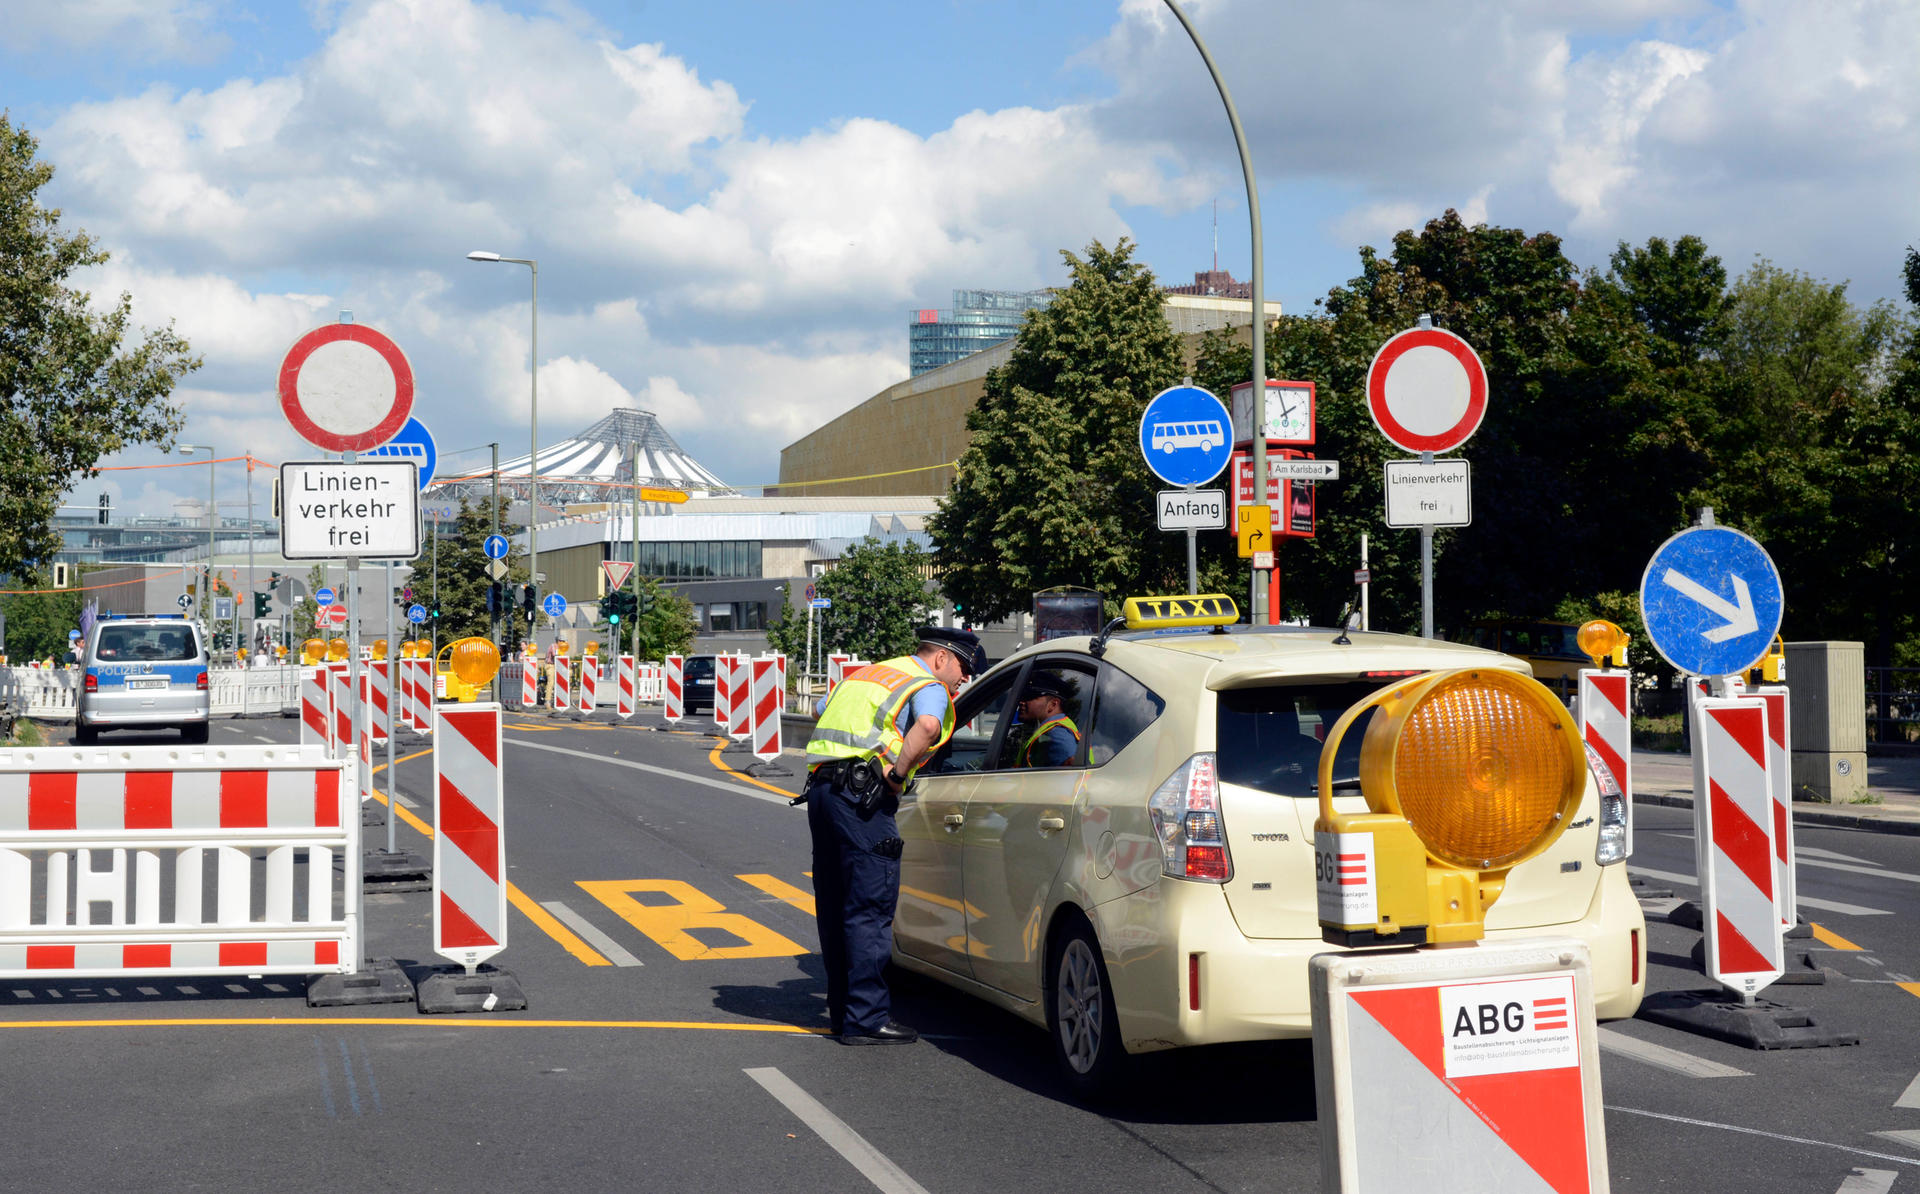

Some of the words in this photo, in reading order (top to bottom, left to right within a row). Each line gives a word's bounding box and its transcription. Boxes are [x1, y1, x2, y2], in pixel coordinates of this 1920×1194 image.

[1275, 464, 1288, 473] Am
[1290, 464, 1323, 474] Karlsbad
[304, 471, 390, 491] Linien-
[1392, 473, 1465, 484] Linienverkehr
[299, 498, 396, 518] verkehr
[1164, 500, 1219, 518] Anfang
[1420, 500, 1438, 511] frei
[1241, 511, 1250, 523] U
[328, 525, 369, 546] frei
[1147, 599, 1223, 618] TAXI
[97, 664, 140, 676] POLIZEI
[1251, 833, 1290, 842] TOYOTA
[1452, 1001, 1525, 1038] ABG
[1453, 1039, 1516, 1051] Baustellenabsicherung
[1518, 1034, 1570, 1046] Lichtsignalanlagen
